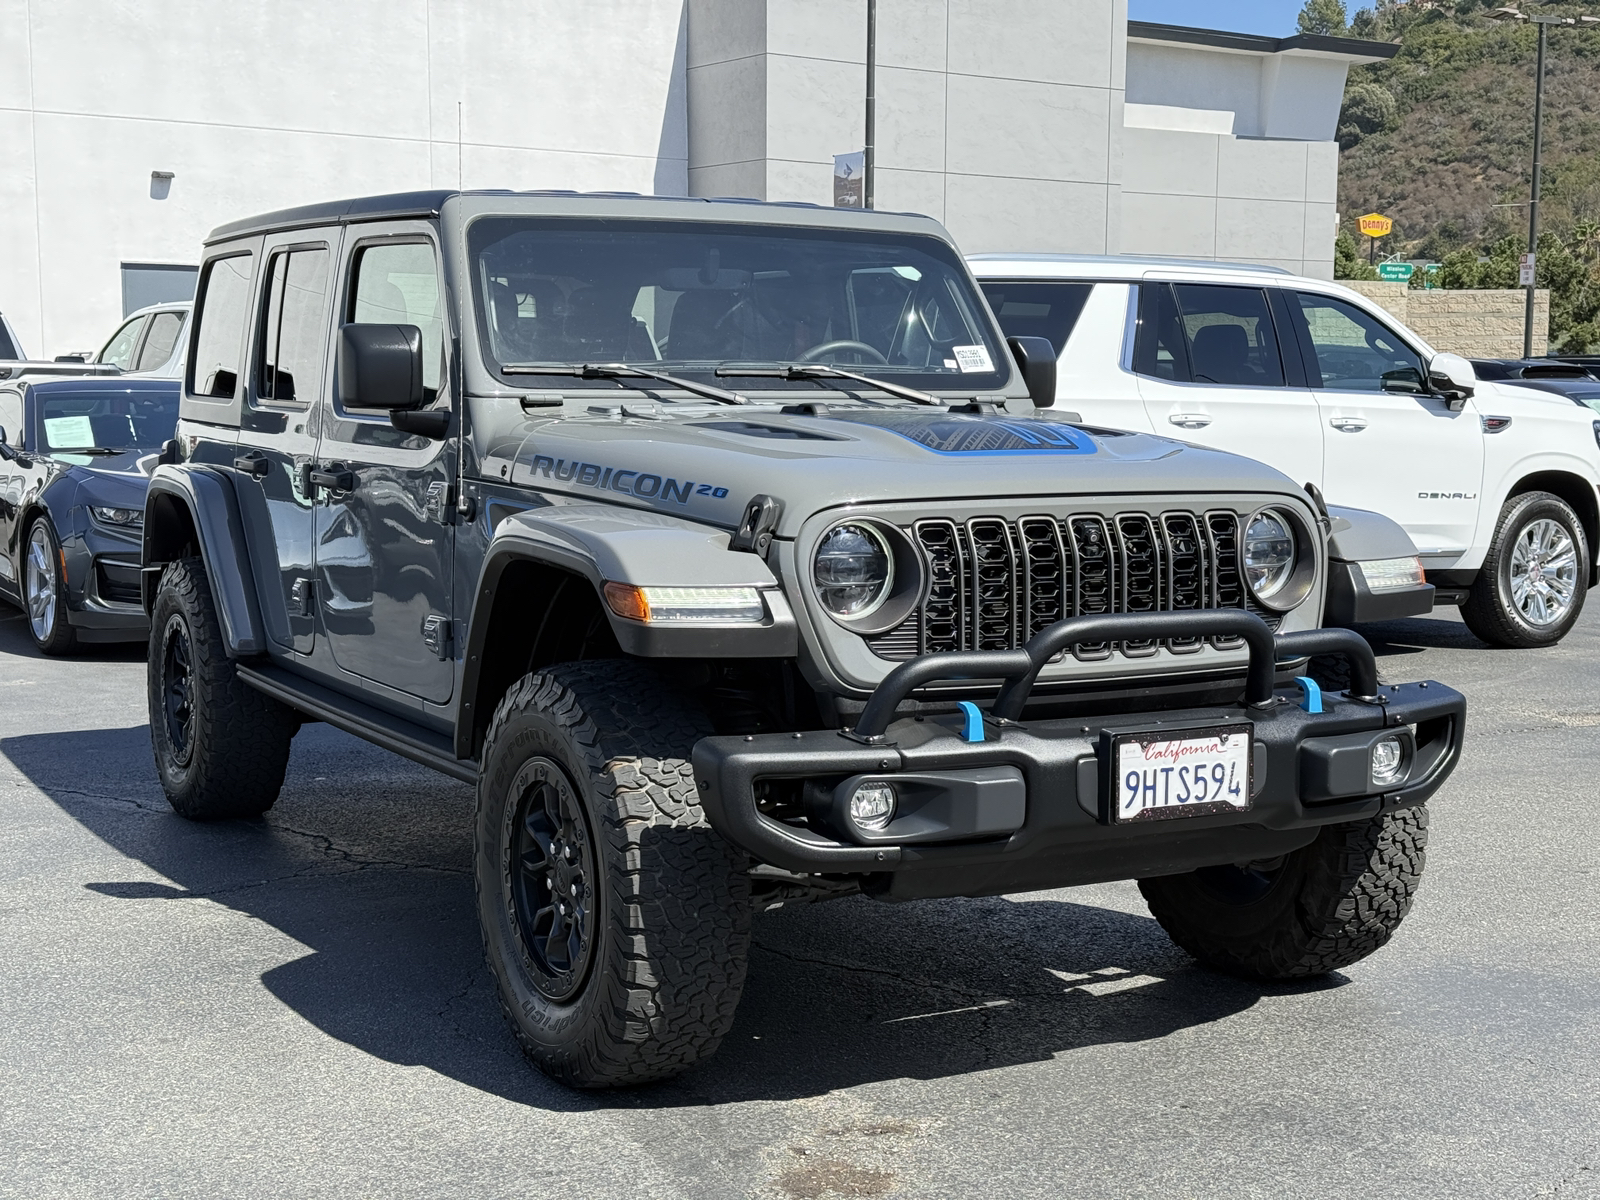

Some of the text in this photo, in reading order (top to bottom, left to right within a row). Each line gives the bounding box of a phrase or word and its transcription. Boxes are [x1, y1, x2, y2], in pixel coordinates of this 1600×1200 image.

[1362, 219, 1389, 231] Denny's
[529, 454, 695, 505] RUBICON
[1144, 740, 1227, 764] California
[1125, 761, 1241, 809] 9HTS594
